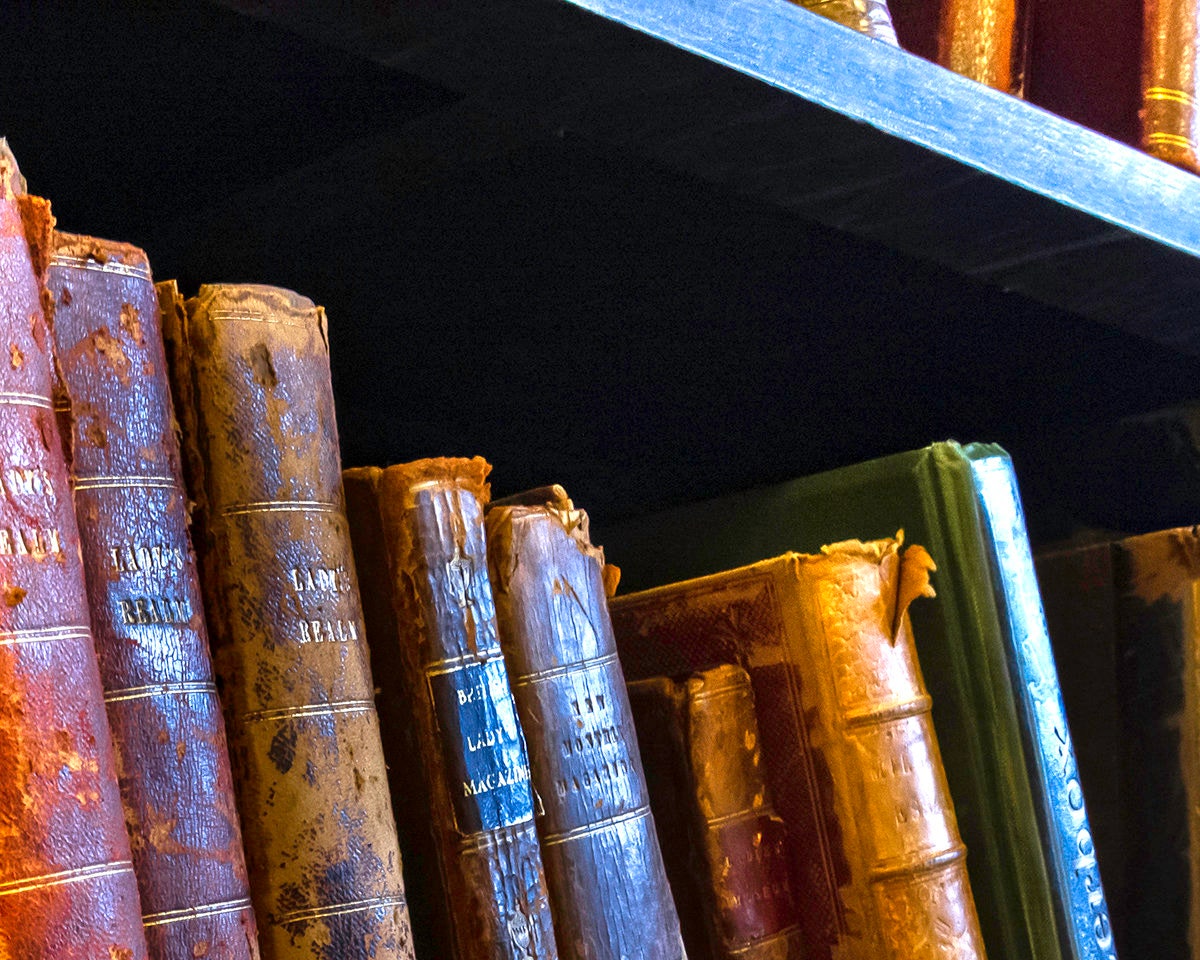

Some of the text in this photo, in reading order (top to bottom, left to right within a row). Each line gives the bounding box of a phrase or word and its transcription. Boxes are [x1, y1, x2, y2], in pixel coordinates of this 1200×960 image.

[110, 546, 185, 572] LADY'S
[119, 599, 191, 624] REALM
[467, 728, 504, 752] LADY
